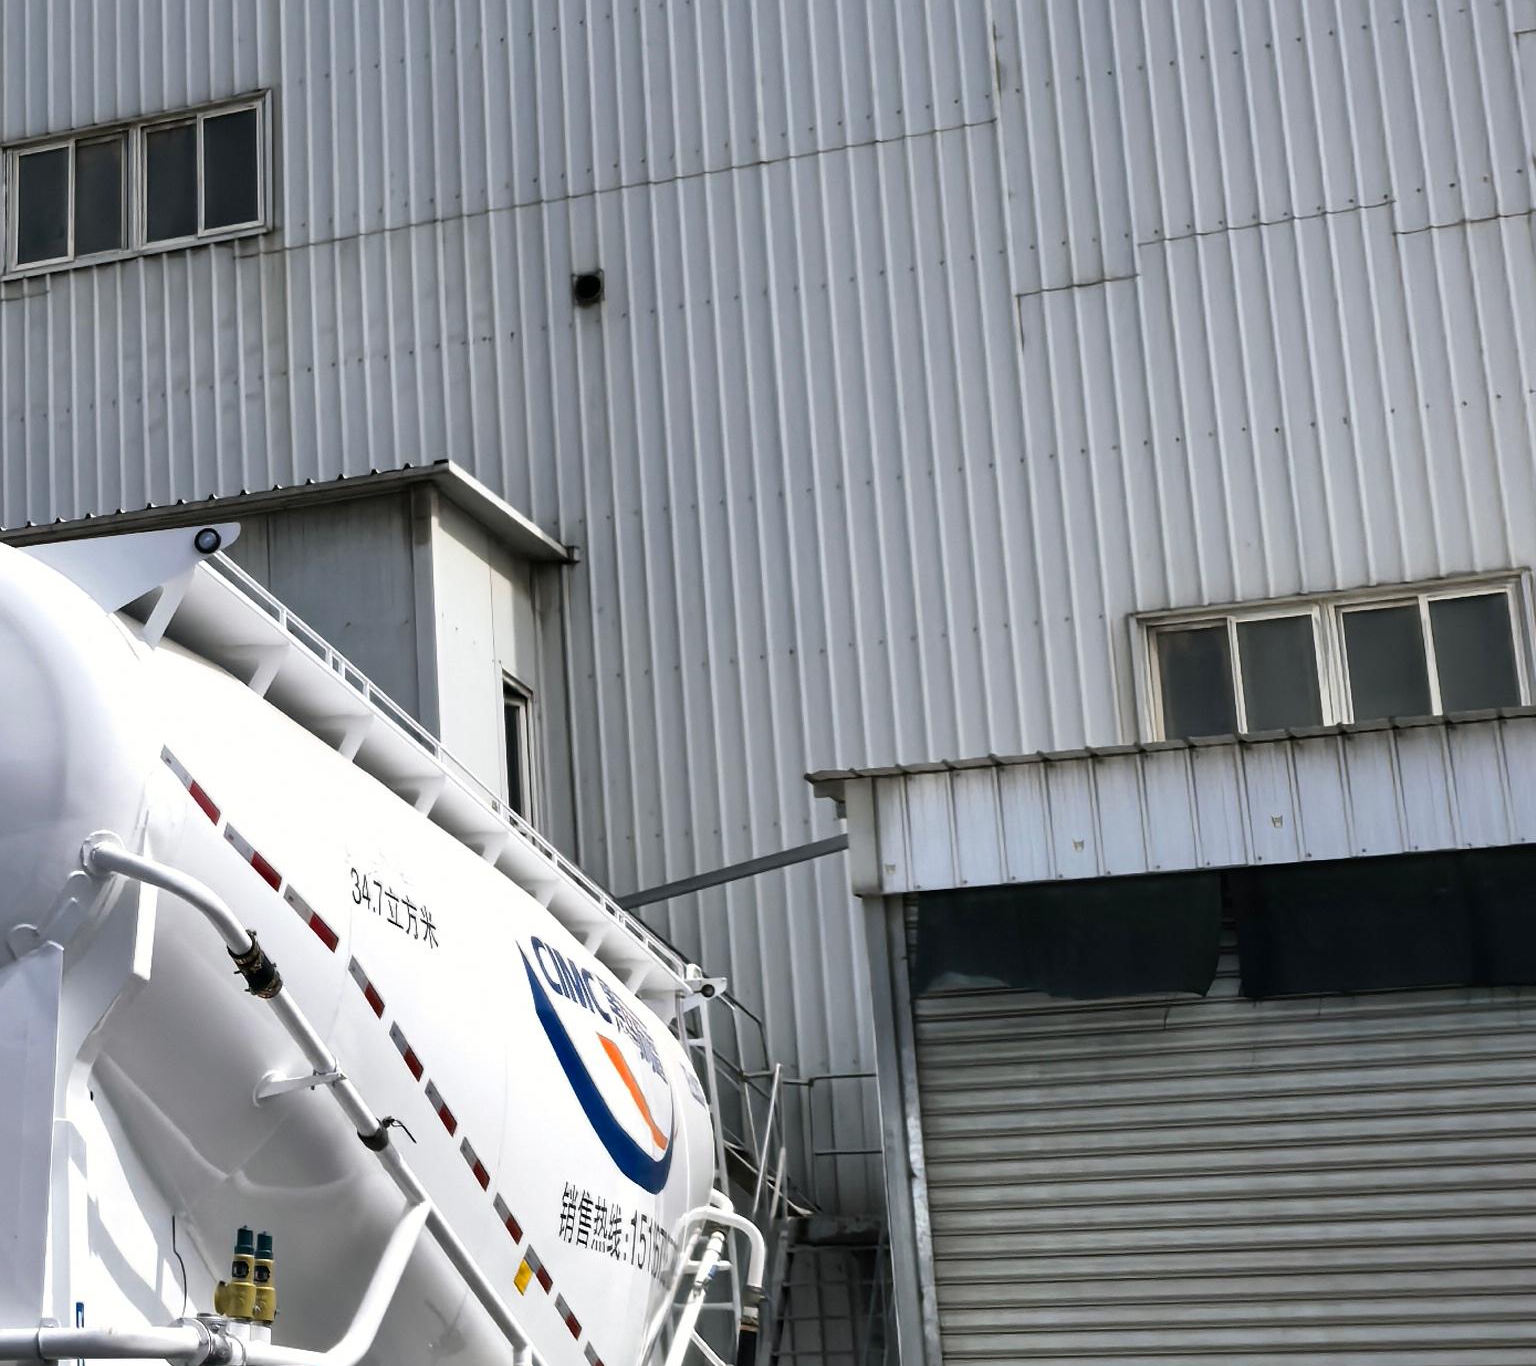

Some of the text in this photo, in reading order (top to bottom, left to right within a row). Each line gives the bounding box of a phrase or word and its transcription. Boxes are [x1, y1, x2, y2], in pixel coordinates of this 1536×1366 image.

[350, 866, 439, 950] 34.7立方米
[530, 935, 614, 1025] CIMC
